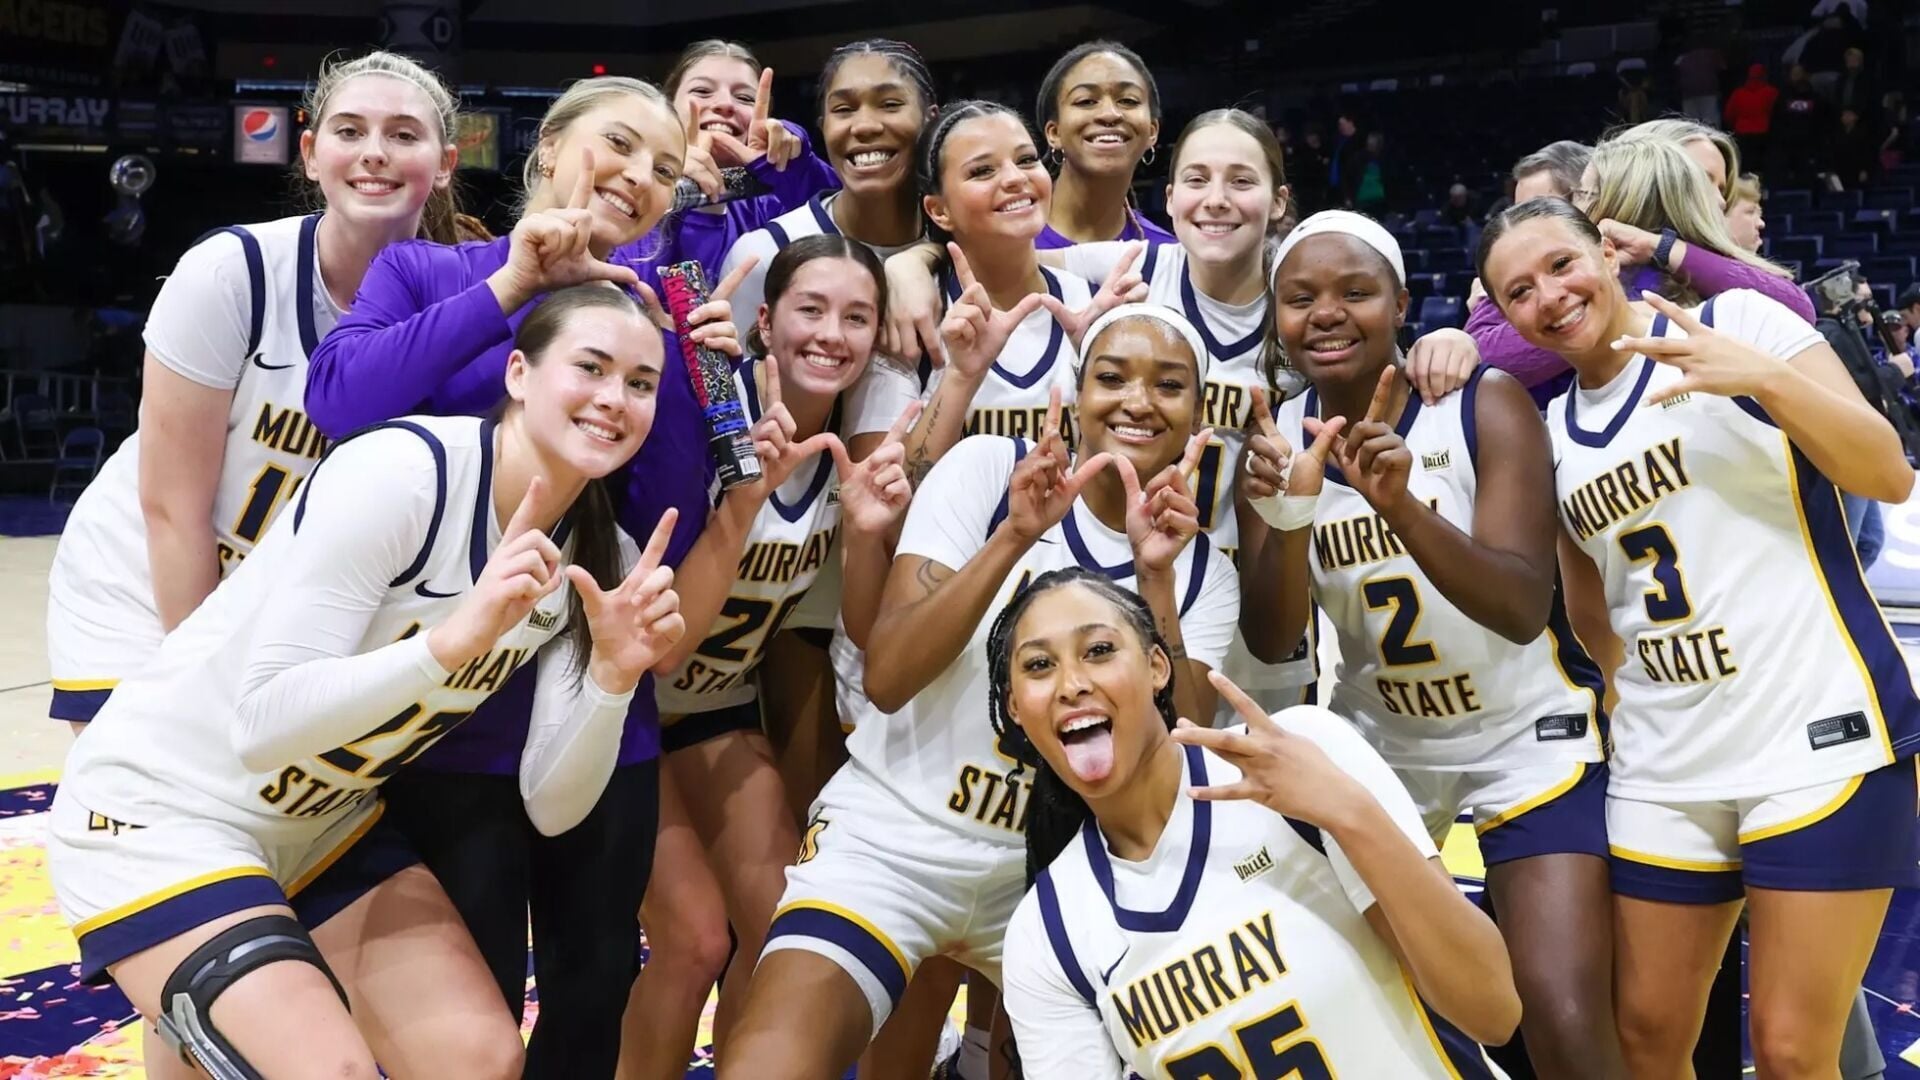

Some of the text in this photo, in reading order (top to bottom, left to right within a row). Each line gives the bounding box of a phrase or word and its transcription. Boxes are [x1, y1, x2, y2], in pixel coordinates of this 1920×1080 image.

[0, 95, 110, 126] URRAY
[231, 461, 306, 547] 1
[1562, 437, 1691, 542] MURRAY
[1617, 520, 1694, 625] 3
[1361, 575, 1441, 668] 2
[1637, 627, 1737, 683] STATE
[1377, 672, 1482, 718] STATE
[1850, 720, 1860, 732] L
[1233, 845, 1272, 880] VALLEY
[1111, 912, 1288, 1048] MURRAY
